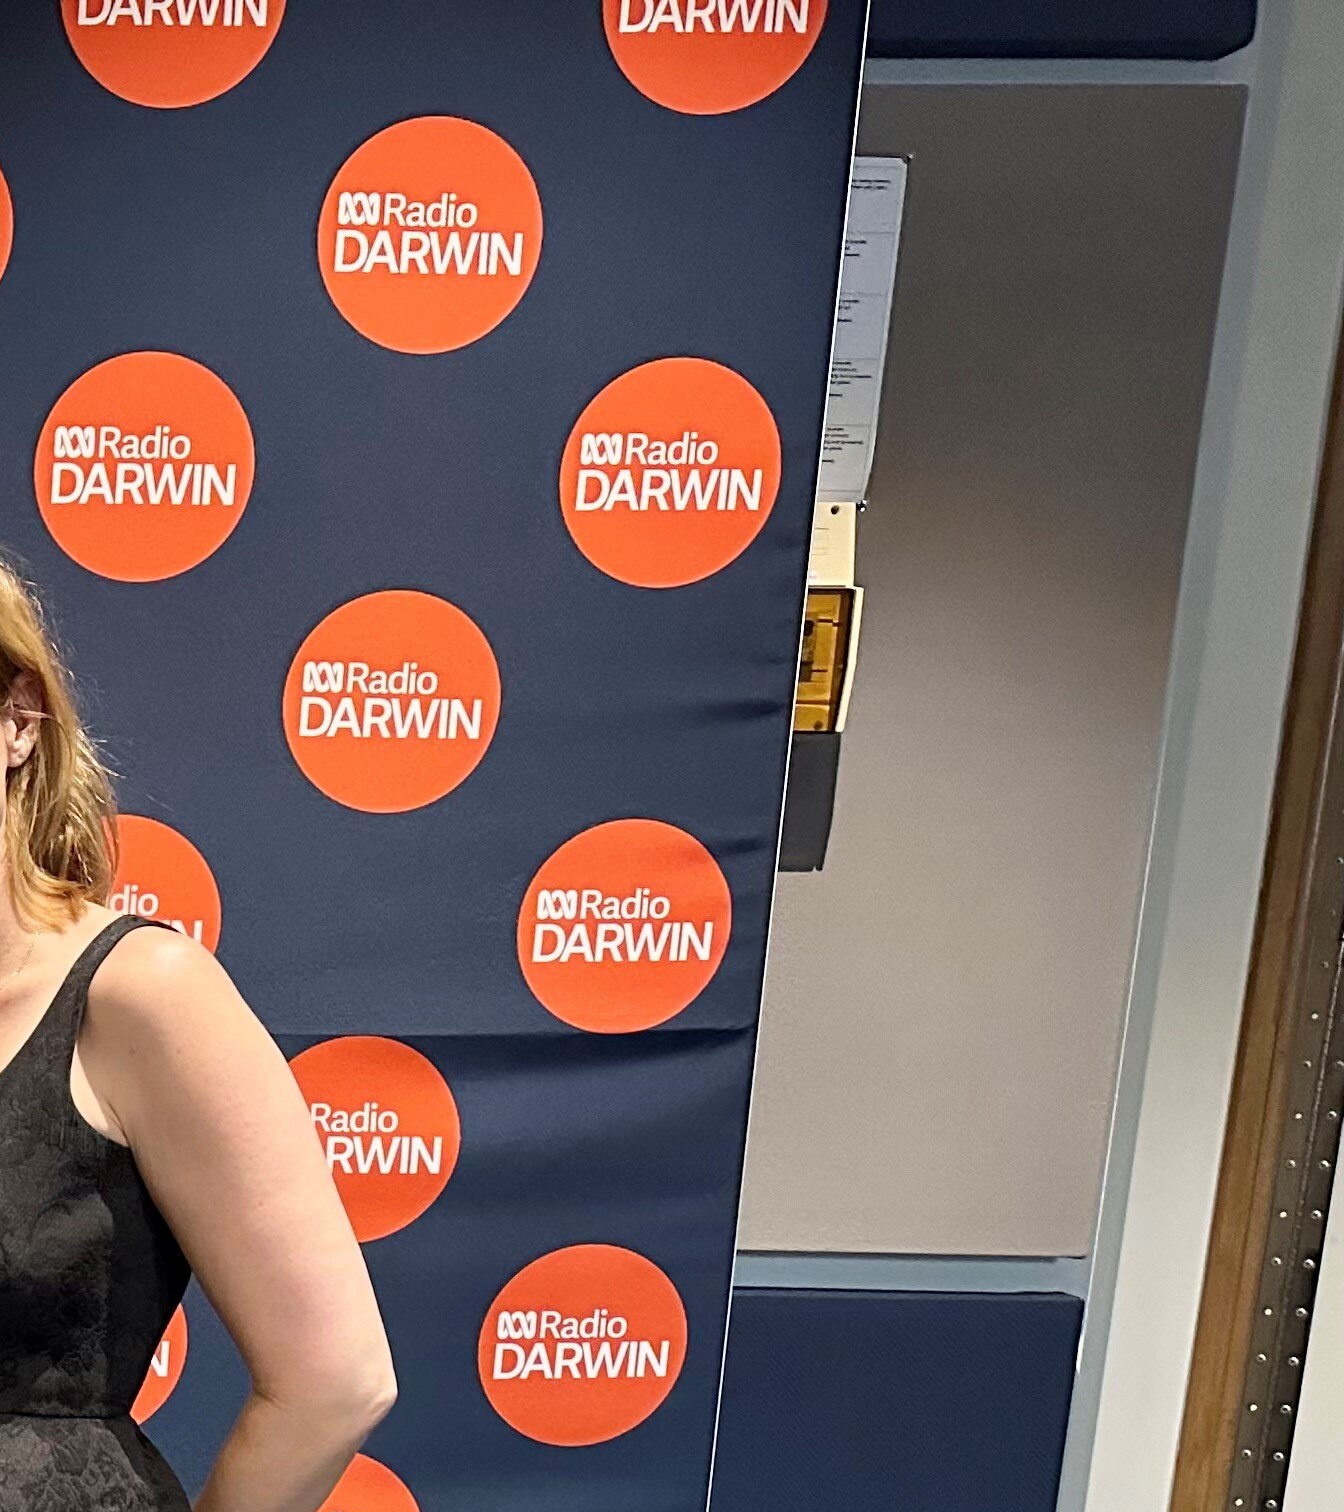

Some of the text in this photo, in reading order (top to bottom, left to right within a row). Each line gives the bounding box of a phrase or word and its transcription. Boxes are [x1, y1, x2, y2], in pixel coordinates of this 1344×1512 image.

[383, 192, 478, 229] Radio
[333, 228, 524, 276] DARWIN
[98, 425, 191, 460] Radio
[624, 431, 719, 466] Radio
[50, 461, 237, 506] DARWIN
[575, 468, 763, 512] DARWIN
[346, 661, 439, 695] Radio
[298, 695, 483, 740] DARWIN
[105, 884, 159, 917] dio
[579, 887, 671, 920] Radio
[532, 921, 714, 963] DARWIN
[310, 1101, 400, 1134] Radio
[325, 1135, 444, 1175] RWIN
[539, 1308, 628, 1340] Radio
[492, 1339, 670, 1380] DARWIN
